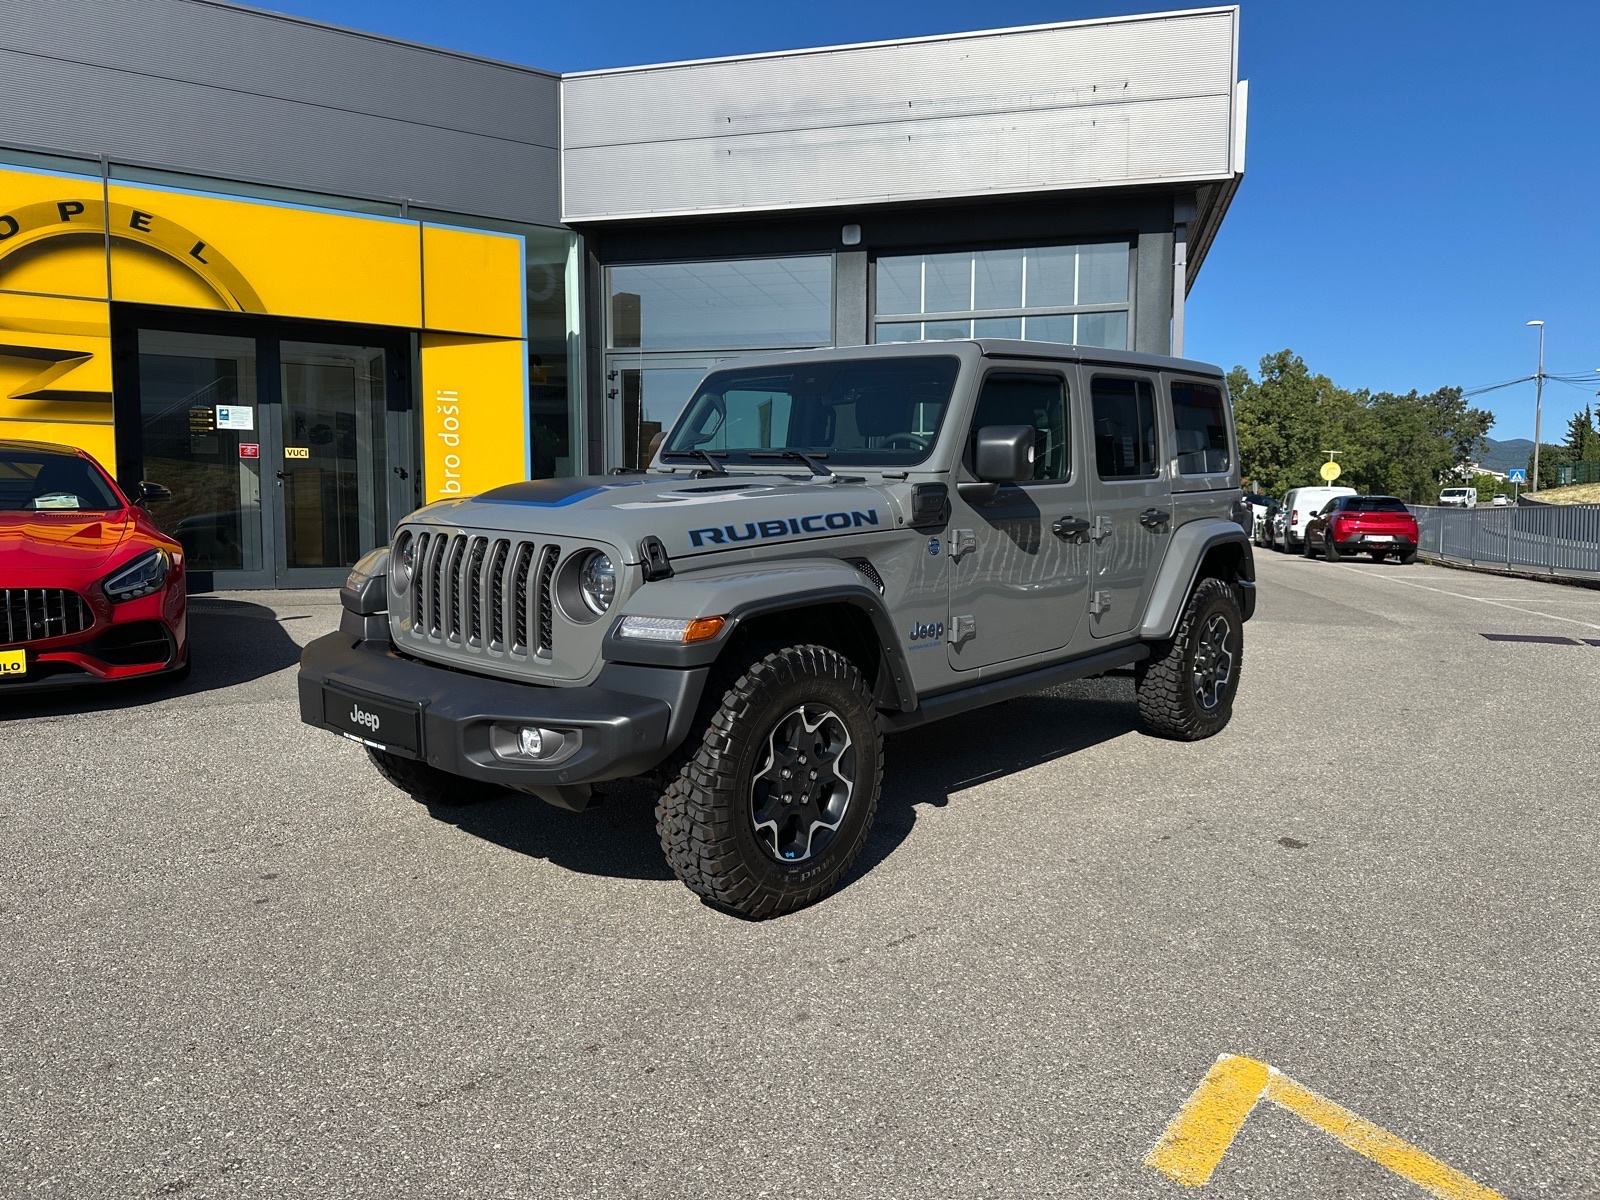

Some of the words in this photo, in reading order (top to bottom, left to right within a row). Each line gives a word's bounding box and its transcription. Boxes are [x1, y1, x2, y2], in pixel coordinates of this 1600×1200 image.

[0, 201, 209, 265] OPEL
[437, 390, 460, 447] došli
[286, 448, 308, 457] VUCI
[688, 509, 879, 547] RUBICON
[910, 621, 944, 641] Jeep
[350, 703, 380, 732] Jeep
